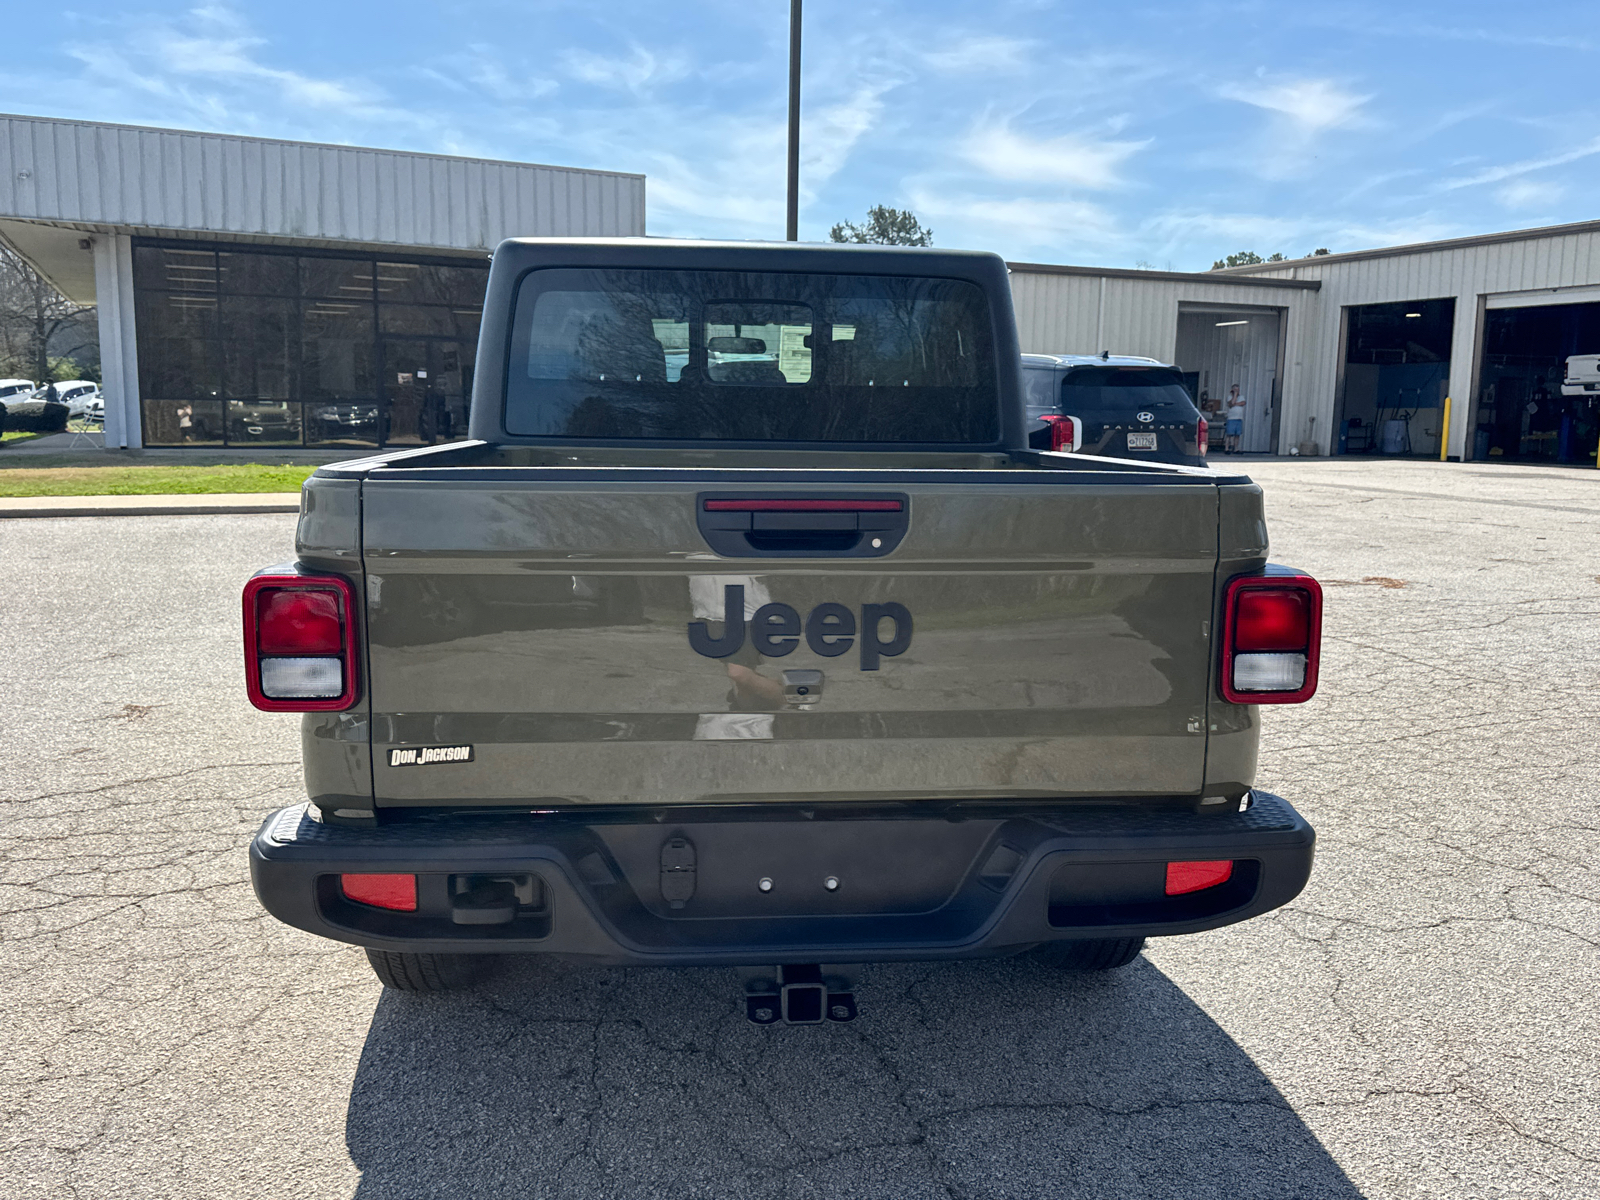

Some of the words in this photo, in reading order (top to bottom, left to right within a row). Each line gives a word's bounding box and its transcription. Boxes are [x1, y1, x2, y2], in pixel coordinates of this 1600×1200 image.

[687, 584, 913, 671] Jeep
[391, 749, 417, 766] DON
[416, 746, 470, 765] JACKSON
